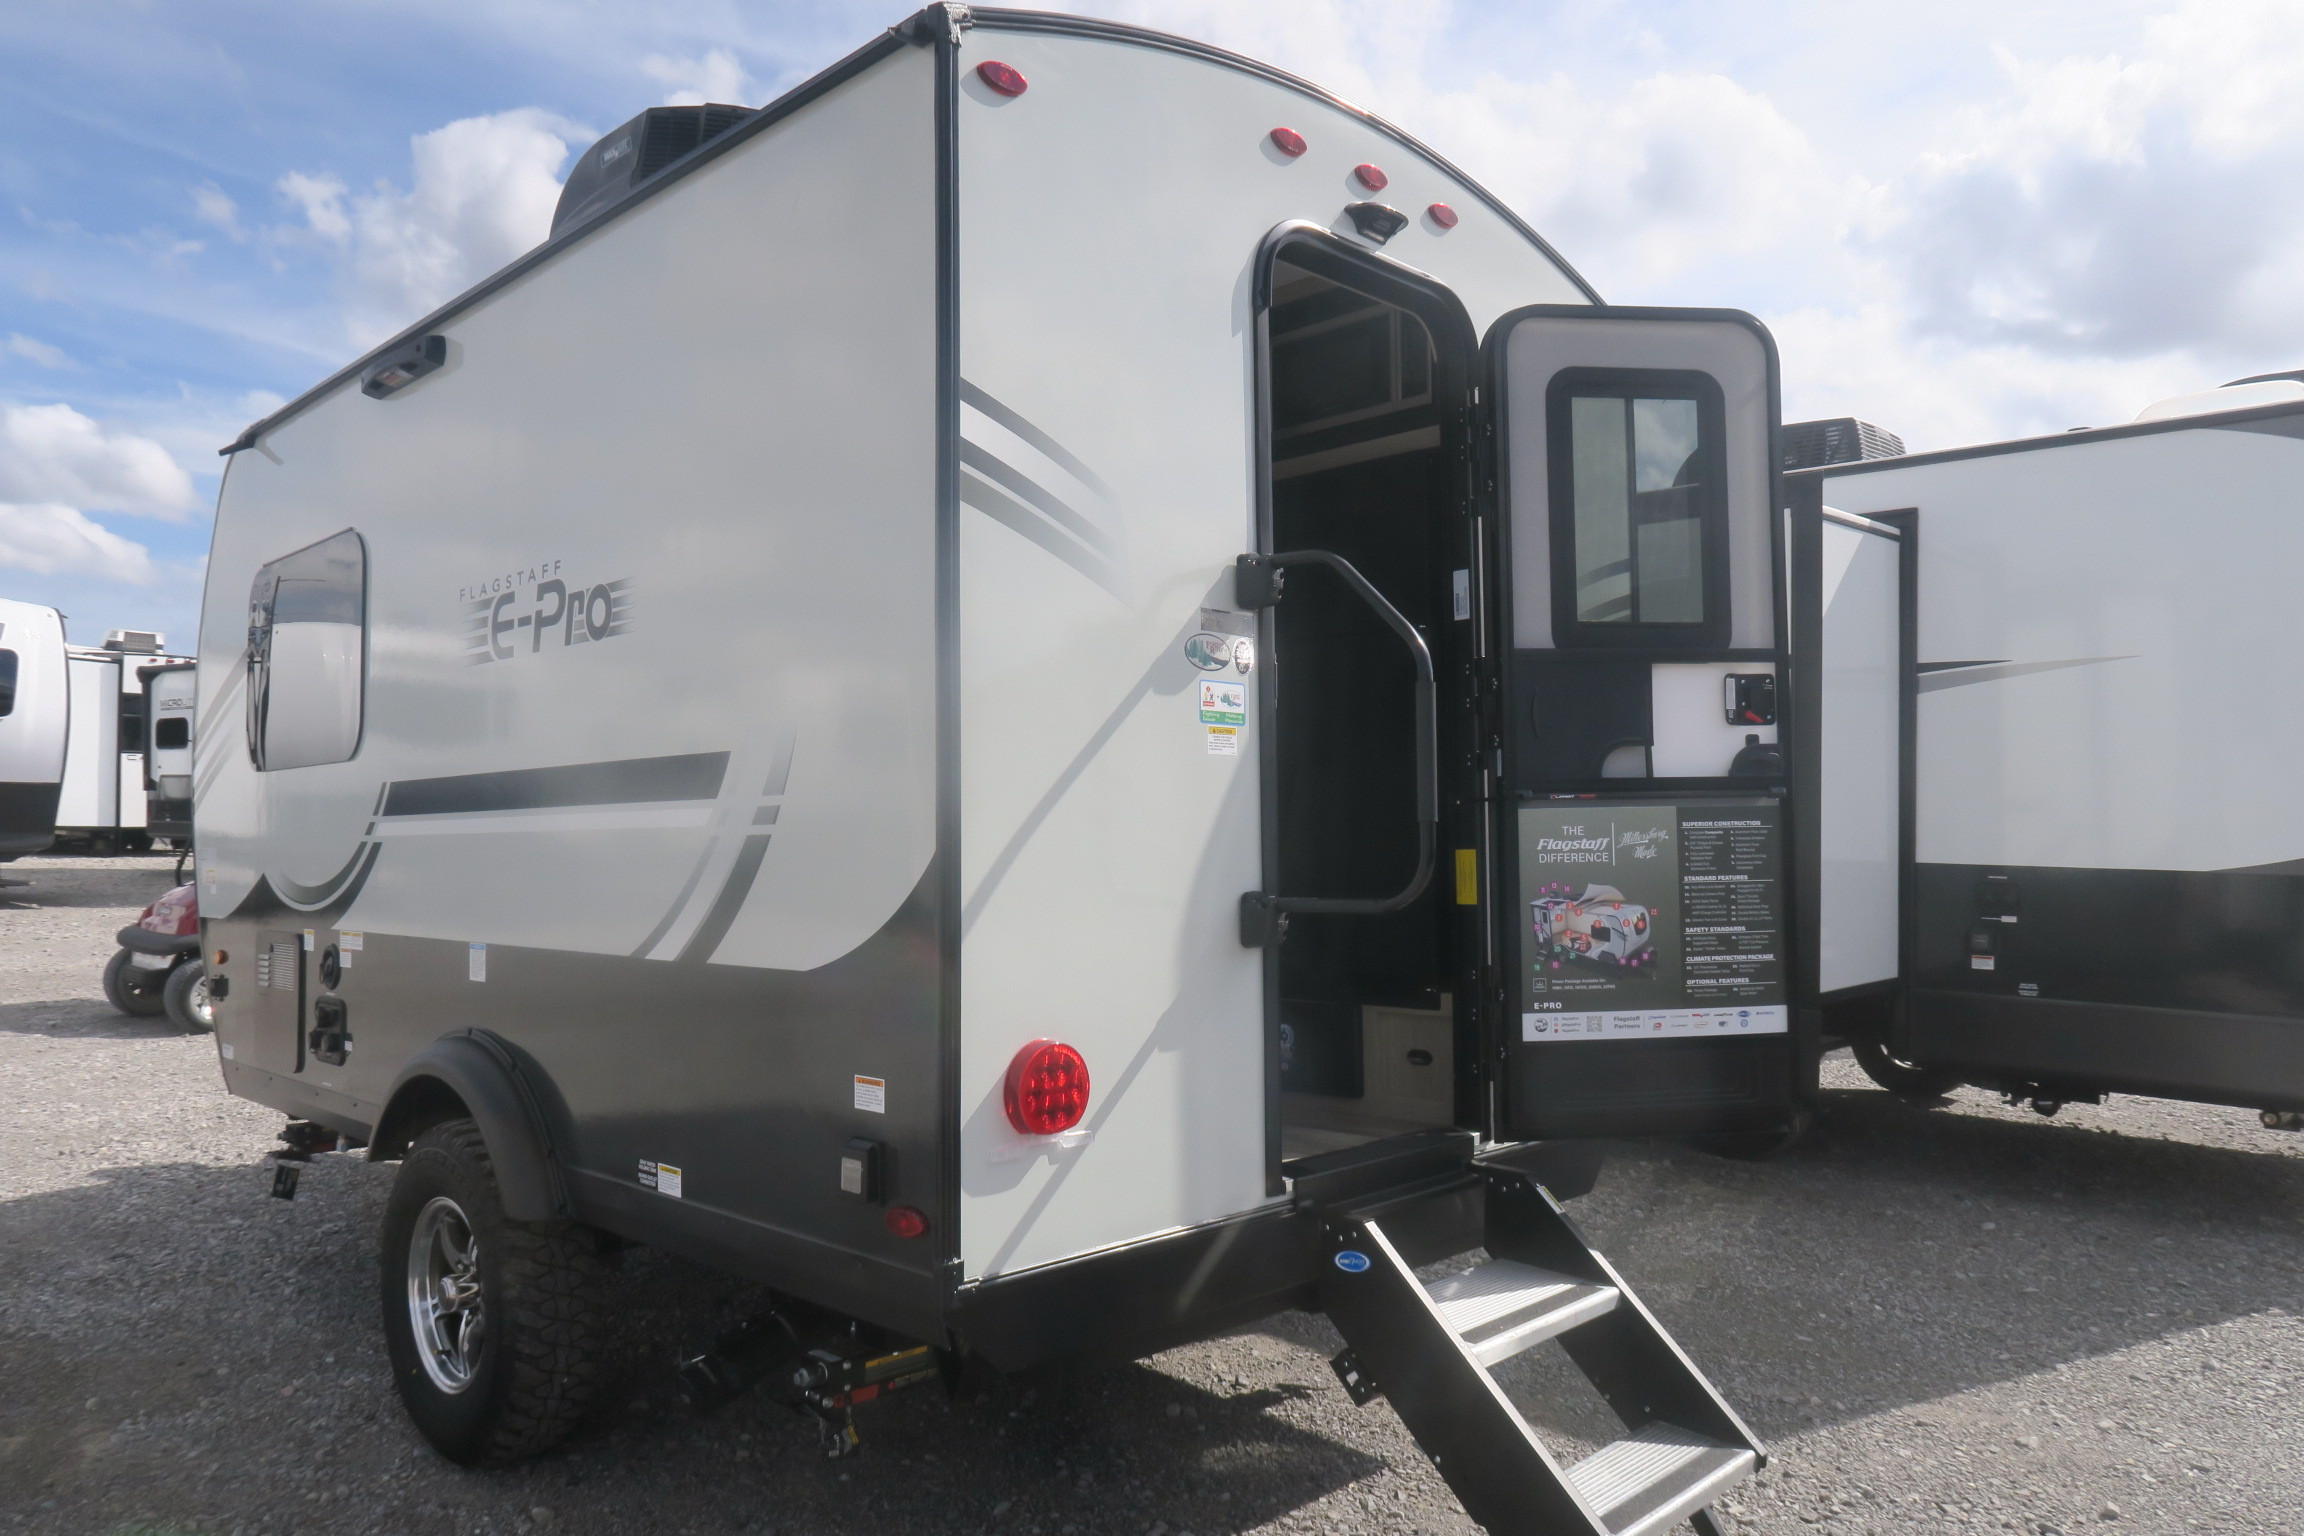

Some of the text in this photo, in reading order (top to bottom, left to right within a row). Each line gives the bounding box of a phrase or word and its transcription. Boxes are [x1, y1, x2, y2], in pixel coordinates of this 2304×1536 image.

[459, 559, 562, 602] FLAGSTAFF
[491, 578, 613, 661] E-Pro
[1562, 826, 1584, 836] THE
[1537, 838, 1610, 851] Flagstaff
[1539, 853, 1609, 863] DIFFERENCE
[1534, 1002, 1562, 1010] E-PRO
